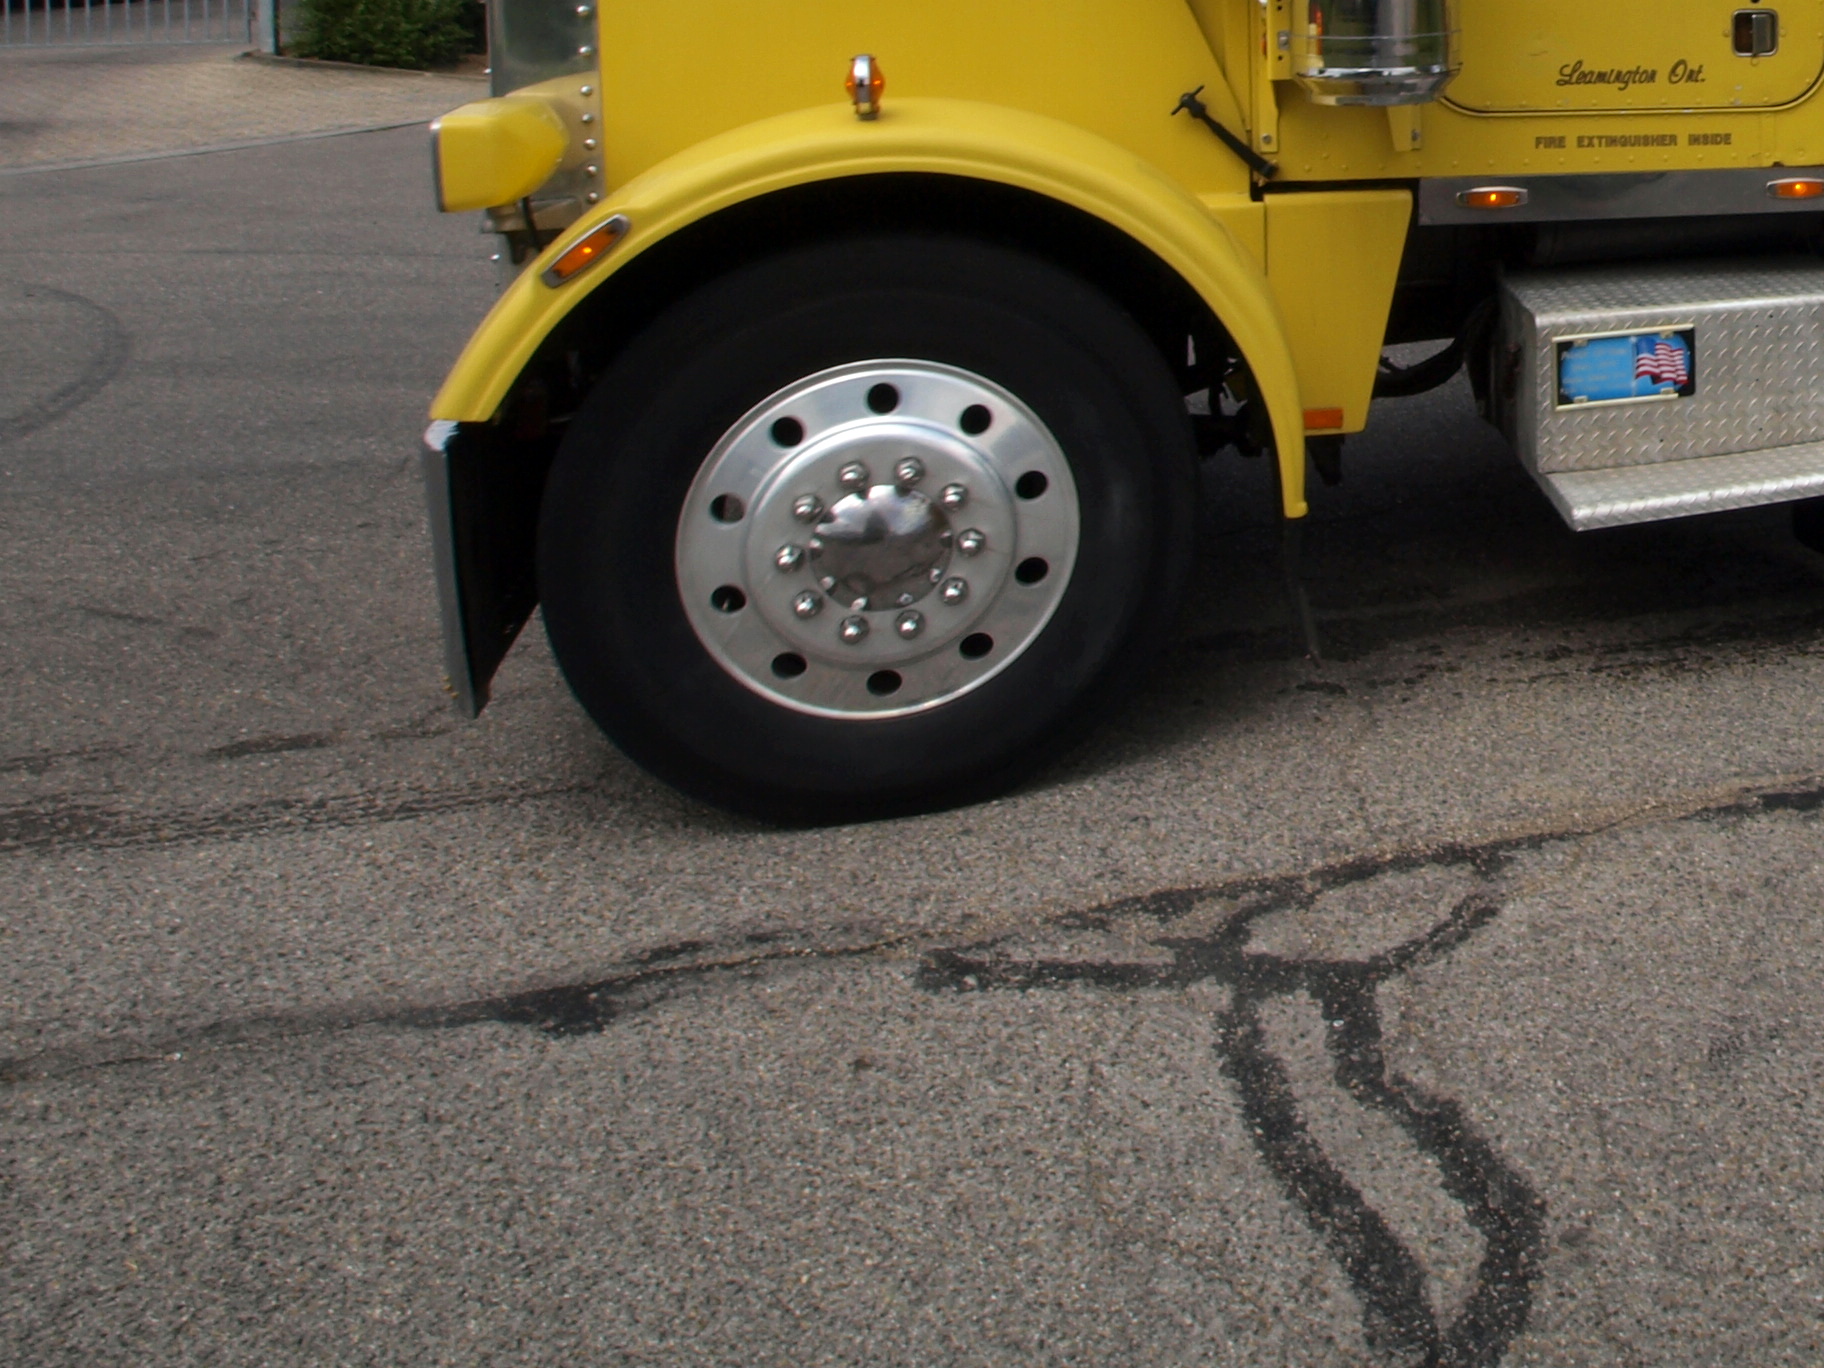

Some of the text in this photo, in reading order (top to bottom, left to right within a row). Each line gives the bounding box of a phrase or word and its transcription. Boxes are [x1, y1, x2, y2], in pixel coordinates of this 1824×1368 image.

[1556, 58, 1706, 91] Leamington Ont.
[1534, 132, 1732, 150] FIRE EXTINGUISHER INSIDE
